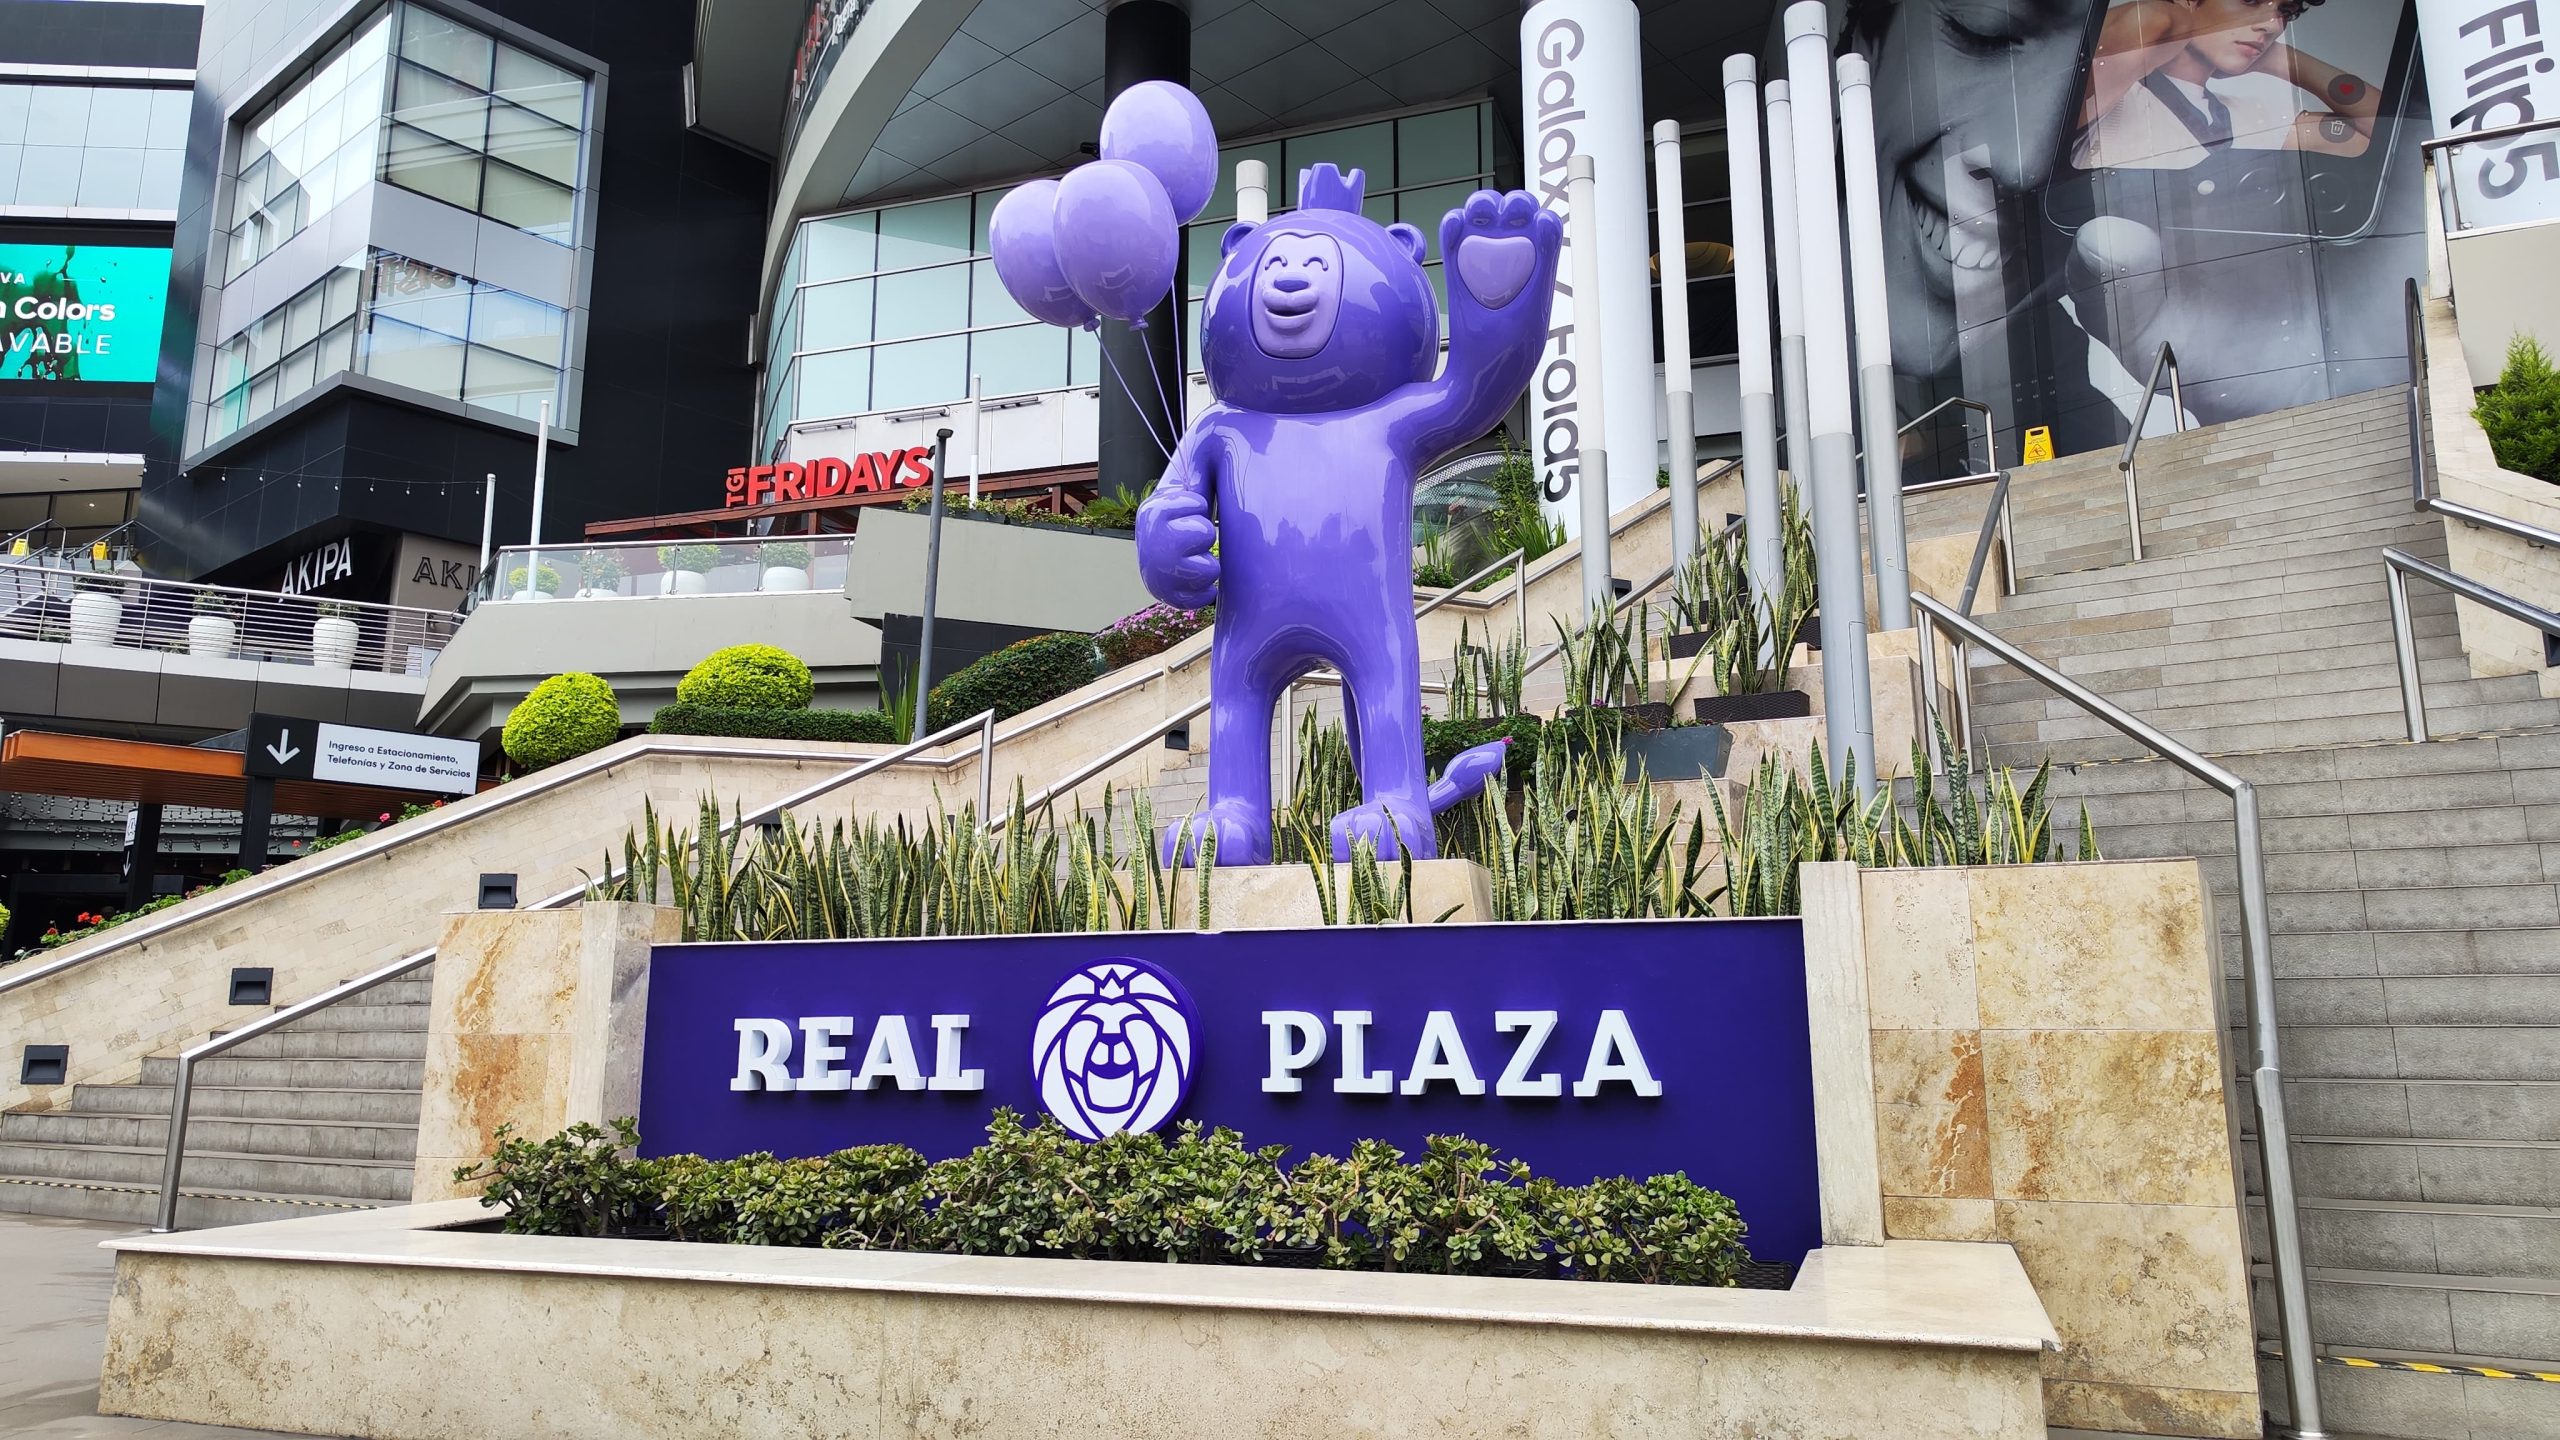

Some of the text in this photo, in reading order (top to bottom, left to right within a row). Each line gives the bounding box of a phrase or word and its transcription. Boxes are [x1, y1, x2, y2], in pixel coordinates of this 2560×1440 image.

[2450, 0, 2560, 200] Flip5
[14, 296, 116, 321] Colors
[0, 332, 113, 355] VABLE
[726, 446, 934, 508] TGI FRIDAYS
[278, 536, 353, 603] AKIPA
[412, 556, 481, 591] AKI
[328, 740, 366, 753] Ingreso
[377, 746, 458, 765] Estacionamiento,
[328, 754, 471, 779] Telefonías y Zona de Servicios
[730, 1009, 1663, 1097] REAL PLAZA
